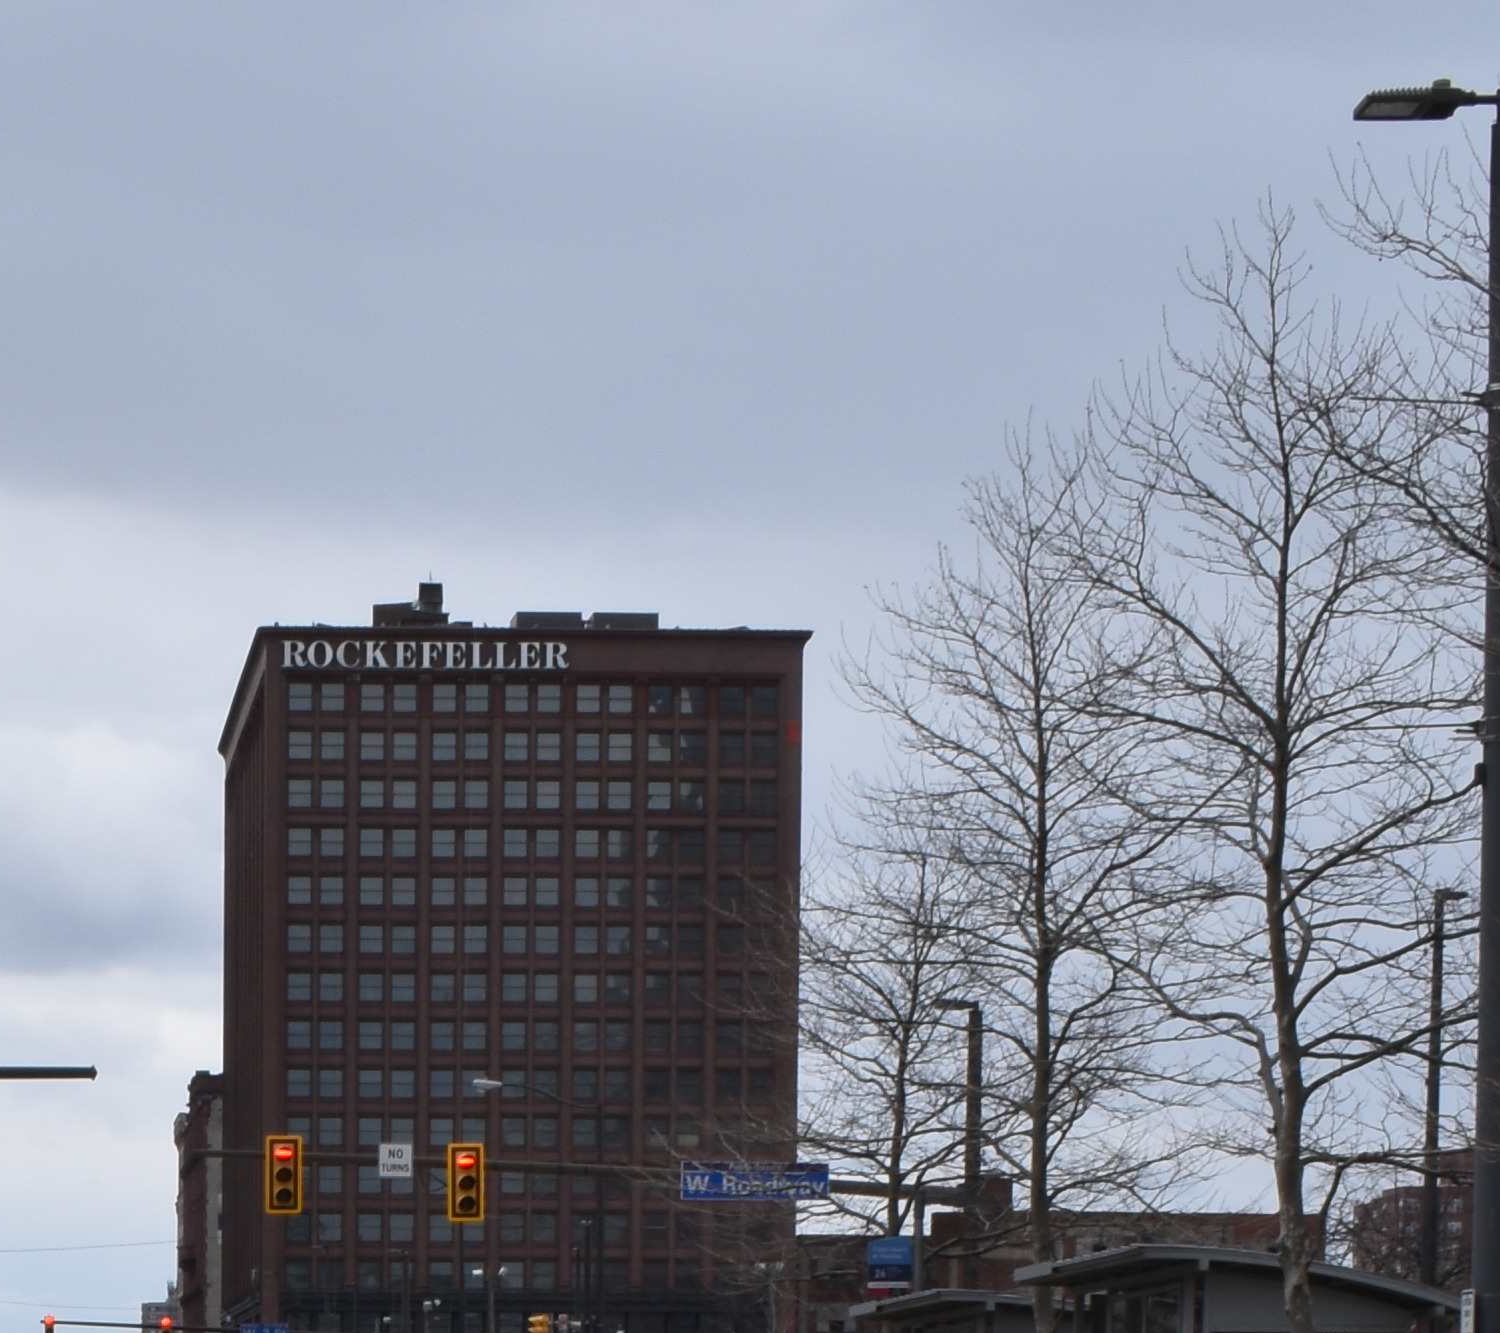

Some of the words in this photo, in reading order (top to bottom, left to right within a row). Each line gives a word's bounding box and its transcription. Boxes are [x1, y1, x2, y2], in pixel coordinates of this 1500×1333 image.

[281, 640, 570, 669] ROCKEFELLER
[388, 1149, 404, 1159] NO
[382, 1163, 409, 1173] TURNS
